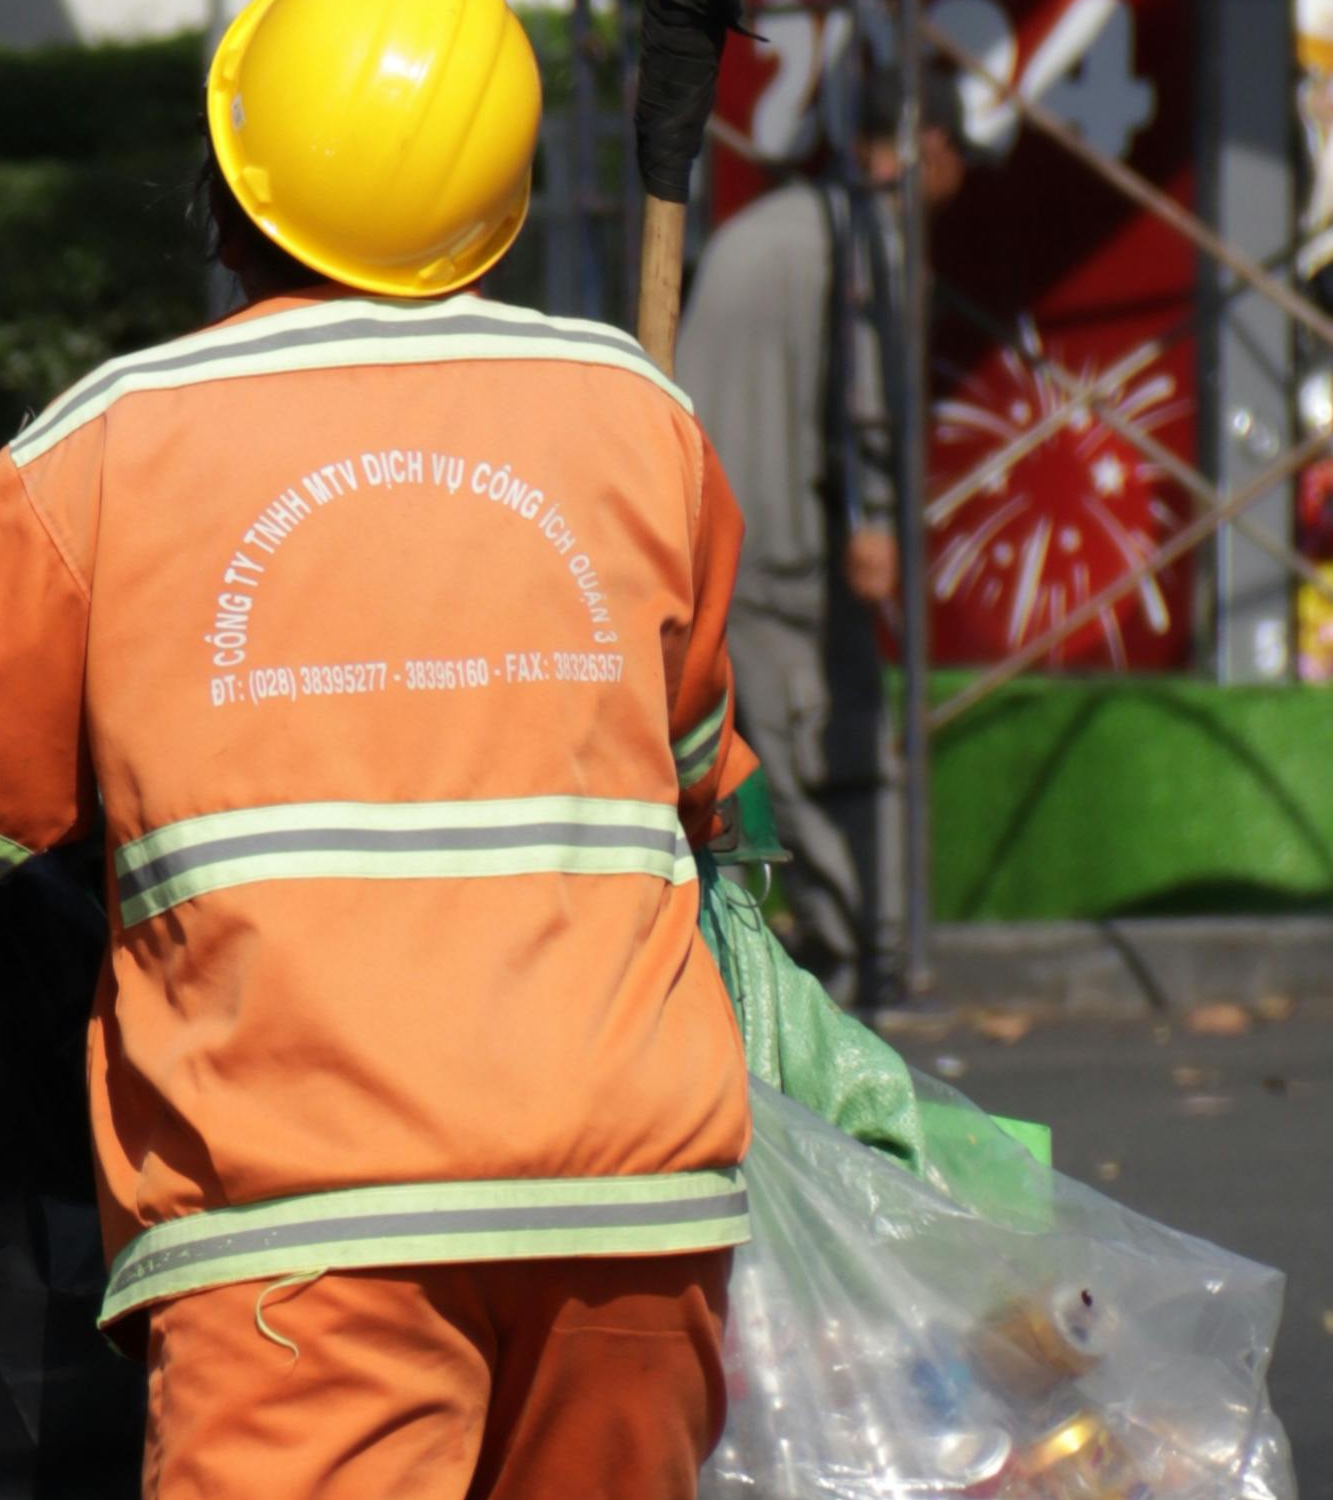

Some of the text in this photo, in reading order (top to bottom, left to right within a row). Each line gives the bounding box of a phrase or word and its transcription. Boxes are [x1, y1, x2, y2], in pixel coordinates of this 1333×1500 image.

[204, 449, 618, 667] CÔNG TY TNHH MTV DỊCH VỤ CÔNG ÍCH QUẬN 3
[210, 674, 246, 707] ĐT:
[248, 666, 297, 706] (028)
[299, 662, 388, 695] 38395277
[405, 658, 489, 690] 38396160
[505, 652, 550, 684] FAX:
